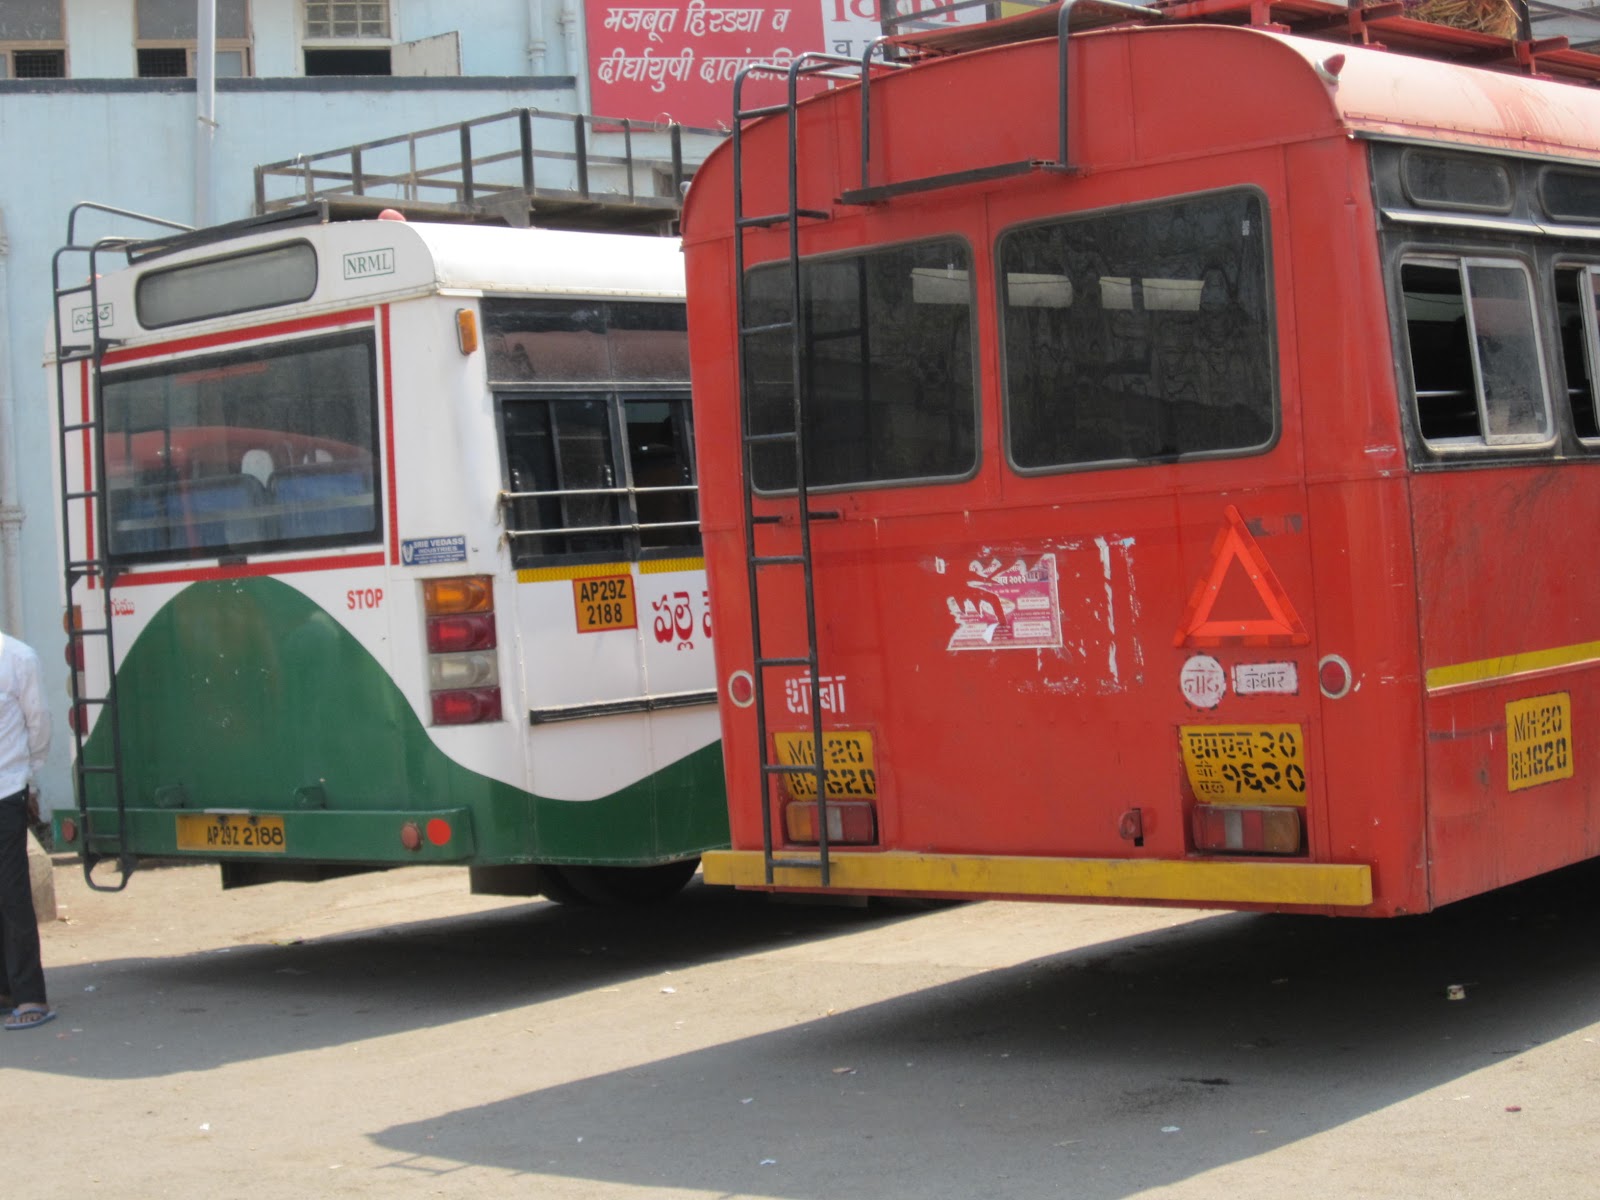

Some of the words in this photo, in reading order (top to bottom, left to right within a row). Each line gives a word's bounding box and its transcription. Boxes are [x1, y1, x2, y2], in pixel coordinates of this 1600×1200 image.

[604, 8, 679, 43] मजबूत
[771, 9, 792, 32] व
[347, 253, 391, 275] NRML
[347, 588, 383, 610] STOP
[580, 580, 627, 603] AP29Z
[587, 603, 623, 625] 2188
[243, 827, 283, 845] 2188
